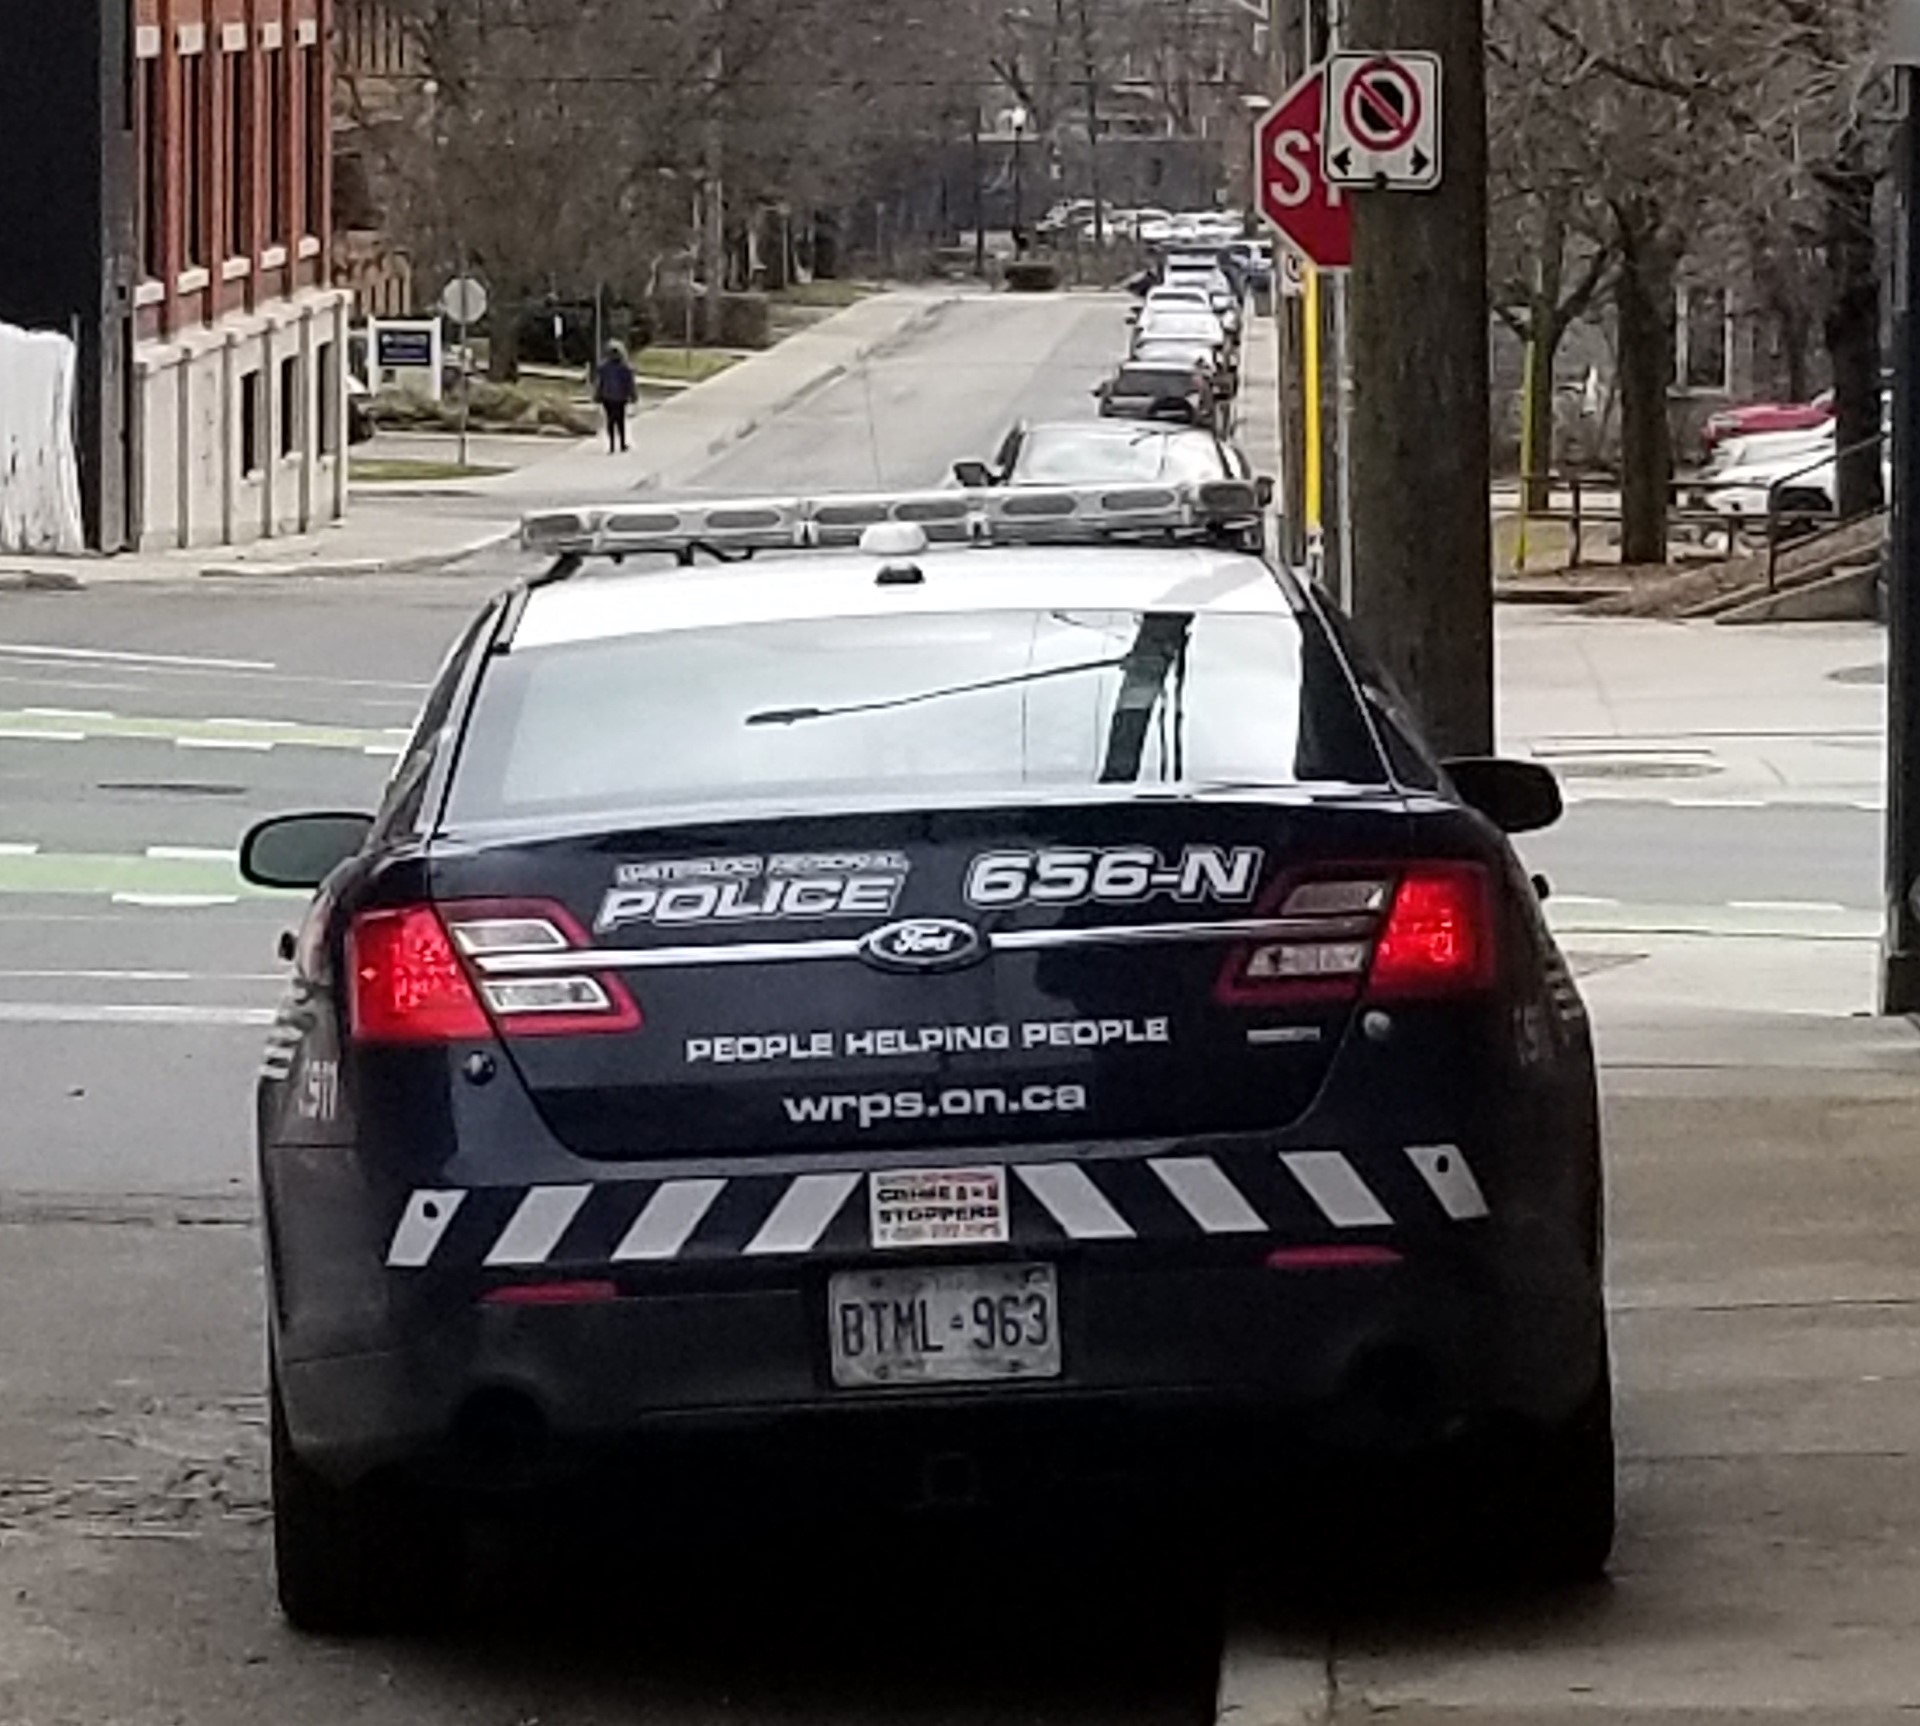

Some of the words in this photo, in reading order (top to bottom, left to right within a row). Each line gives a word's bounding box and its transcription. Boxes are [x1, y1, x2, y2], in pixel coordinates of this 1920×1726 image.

[1269, 130, 1341, 207] S
[967, 848, 1258, 905] 656-N
[597, 877, 900, 928] POLICE
[686, 1032, 834, 1062] PEOPLE
[845, 1024, 1010, 1056] HELPING
[1021, 1016, 1170, 1049] PEOPLE
[782, 1084, 1087, 1128] wrps.on.ca
[878, 1205, 1000, 1225] STOPPERS
